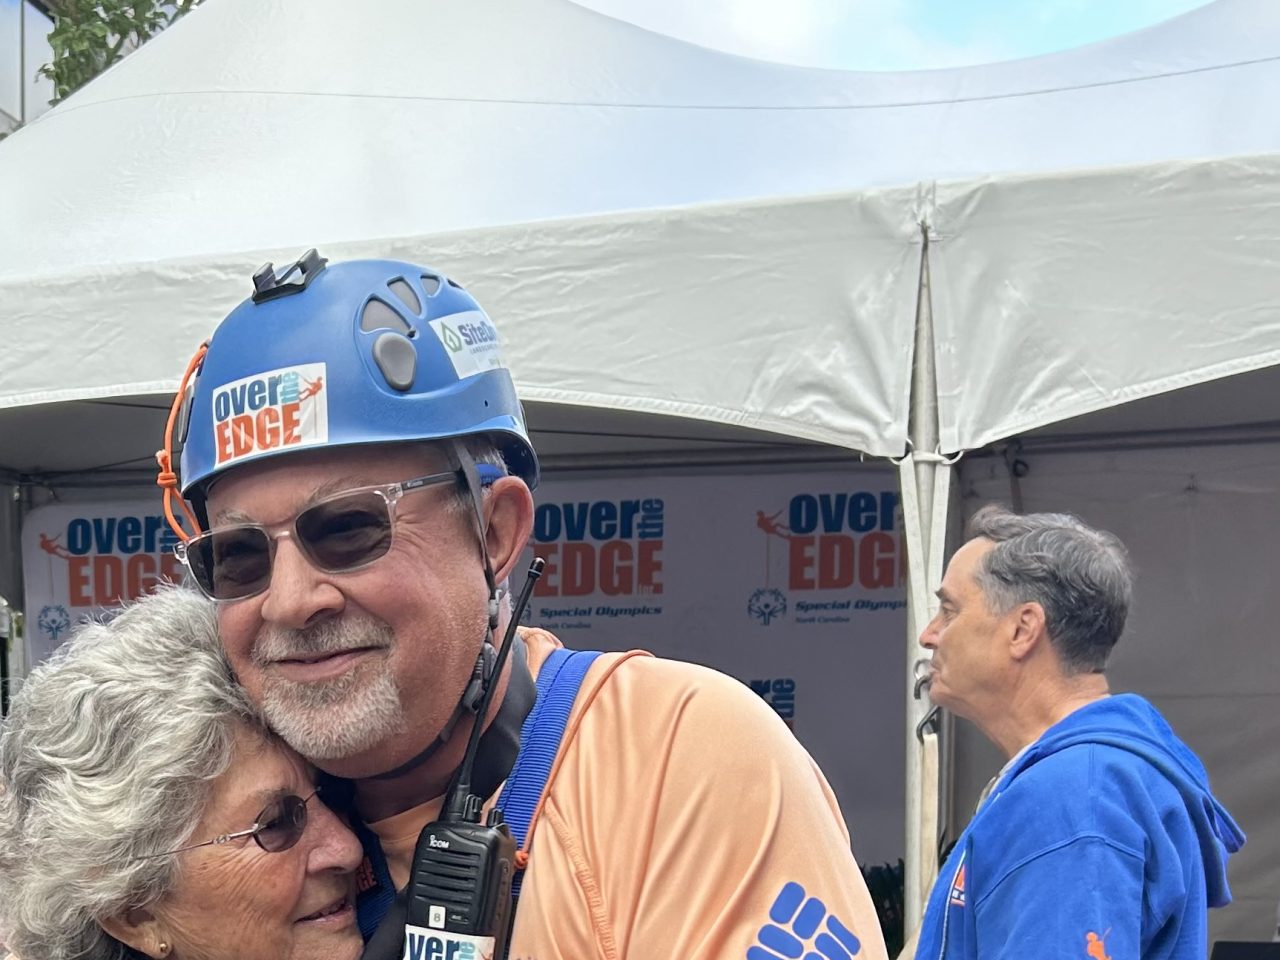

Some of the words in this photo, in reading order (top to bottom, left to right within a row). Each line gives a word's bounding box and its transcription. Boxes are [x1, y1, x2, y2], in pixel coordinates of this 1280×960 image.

[215, 375, 282, 422] over
[279, 371, 300, 404] the
[216, 402, 302, 464] EDGE
[534, 500, 640, 542] over
[637, 498, 664, 539] the
[789, 491, 901, 534] over
[68, 516, 162, 555] over
[532, 540, 663, 597] EDGE
[788, 531, 907, 592] EDG
[539, 606, 593, 619] Special
[595, 604, 663, 617] Olympics
[795, 599, 851, 614] Special
